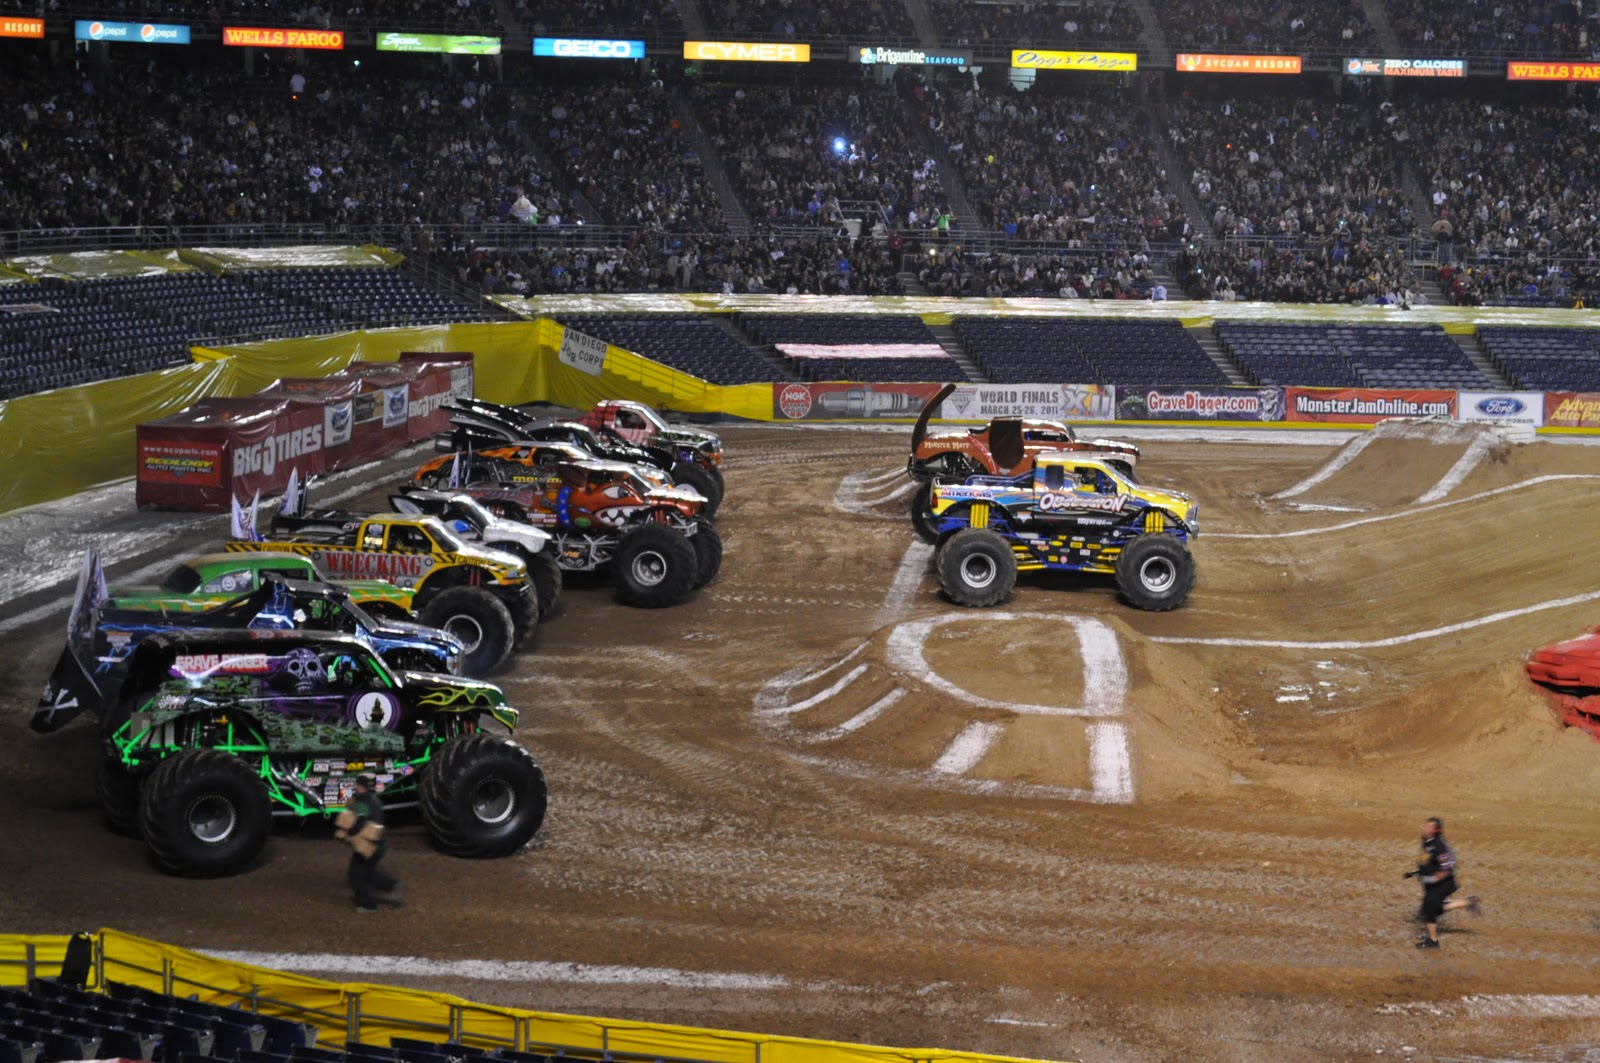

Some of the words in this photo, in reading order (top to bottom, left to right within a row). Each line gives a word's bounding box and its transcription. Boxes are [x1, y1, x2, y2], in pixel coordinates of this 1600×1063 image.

[4, 22, 42, 33] RESORT
[104, 27, 127, 37] pepsi
[155, 29, 178, 39] pepsi
[226, 29, 284, 45] WELLS
[286, 32, 342, 47] FARGO
[553, 39, 631, 58] GEICO
[697, 43, 797, 60] CYMER
[876, 47, 925, 64] Brigantine
[1017, 52, 1072, 67] Oggi's
[1076, 54, 1130, 68] Pizza
[1205, 59, 1250, 68] SYCUAN
[1255, 60, 1298, 69] RESORT
[1384, 59, 1411, 68] ZERO
[1412, 60, 1463, 69] CALORIES
[1383, 67, 1435, 76] MAXIMUM
[1437, 68, 1463, 77] TASTE
[1511, 65, 1570, 79] WELLS
[563, 328, 580, 343] SAN
[581, 335, 607, 354] DIEGO
[578, 350, 604, 369] CORPS
[785, 392, 806, 401] NGK
[980, 391, 1018, 403] WORLD
[1022, 391, 1059, 404] FINALS
[980, 405, 1009, 415] MARCH
[1041, 405, 1059, 415] 2011
[1148, 391, 1258, 416] GraveDigger.com
[1296, 396, 1448, 415] MonsterJamOnline.com
[1486, 400, 1516, 413] Ford
[1550, 409, 1580, 420] Auto
[143, 446, 218, 456] www.ecoparts.com
[233, 443, 262, 477] BIG
[276, 423, 322, 462] TIRES
[924, 441, 950, 449] MONSTER
[940, 488, 992, 498] AmeriGas
[262, 544, 290, 552] CAUTION
[325, 552, 422, 576] WRECKING
[175, 654, 219, 672] GRAVE
